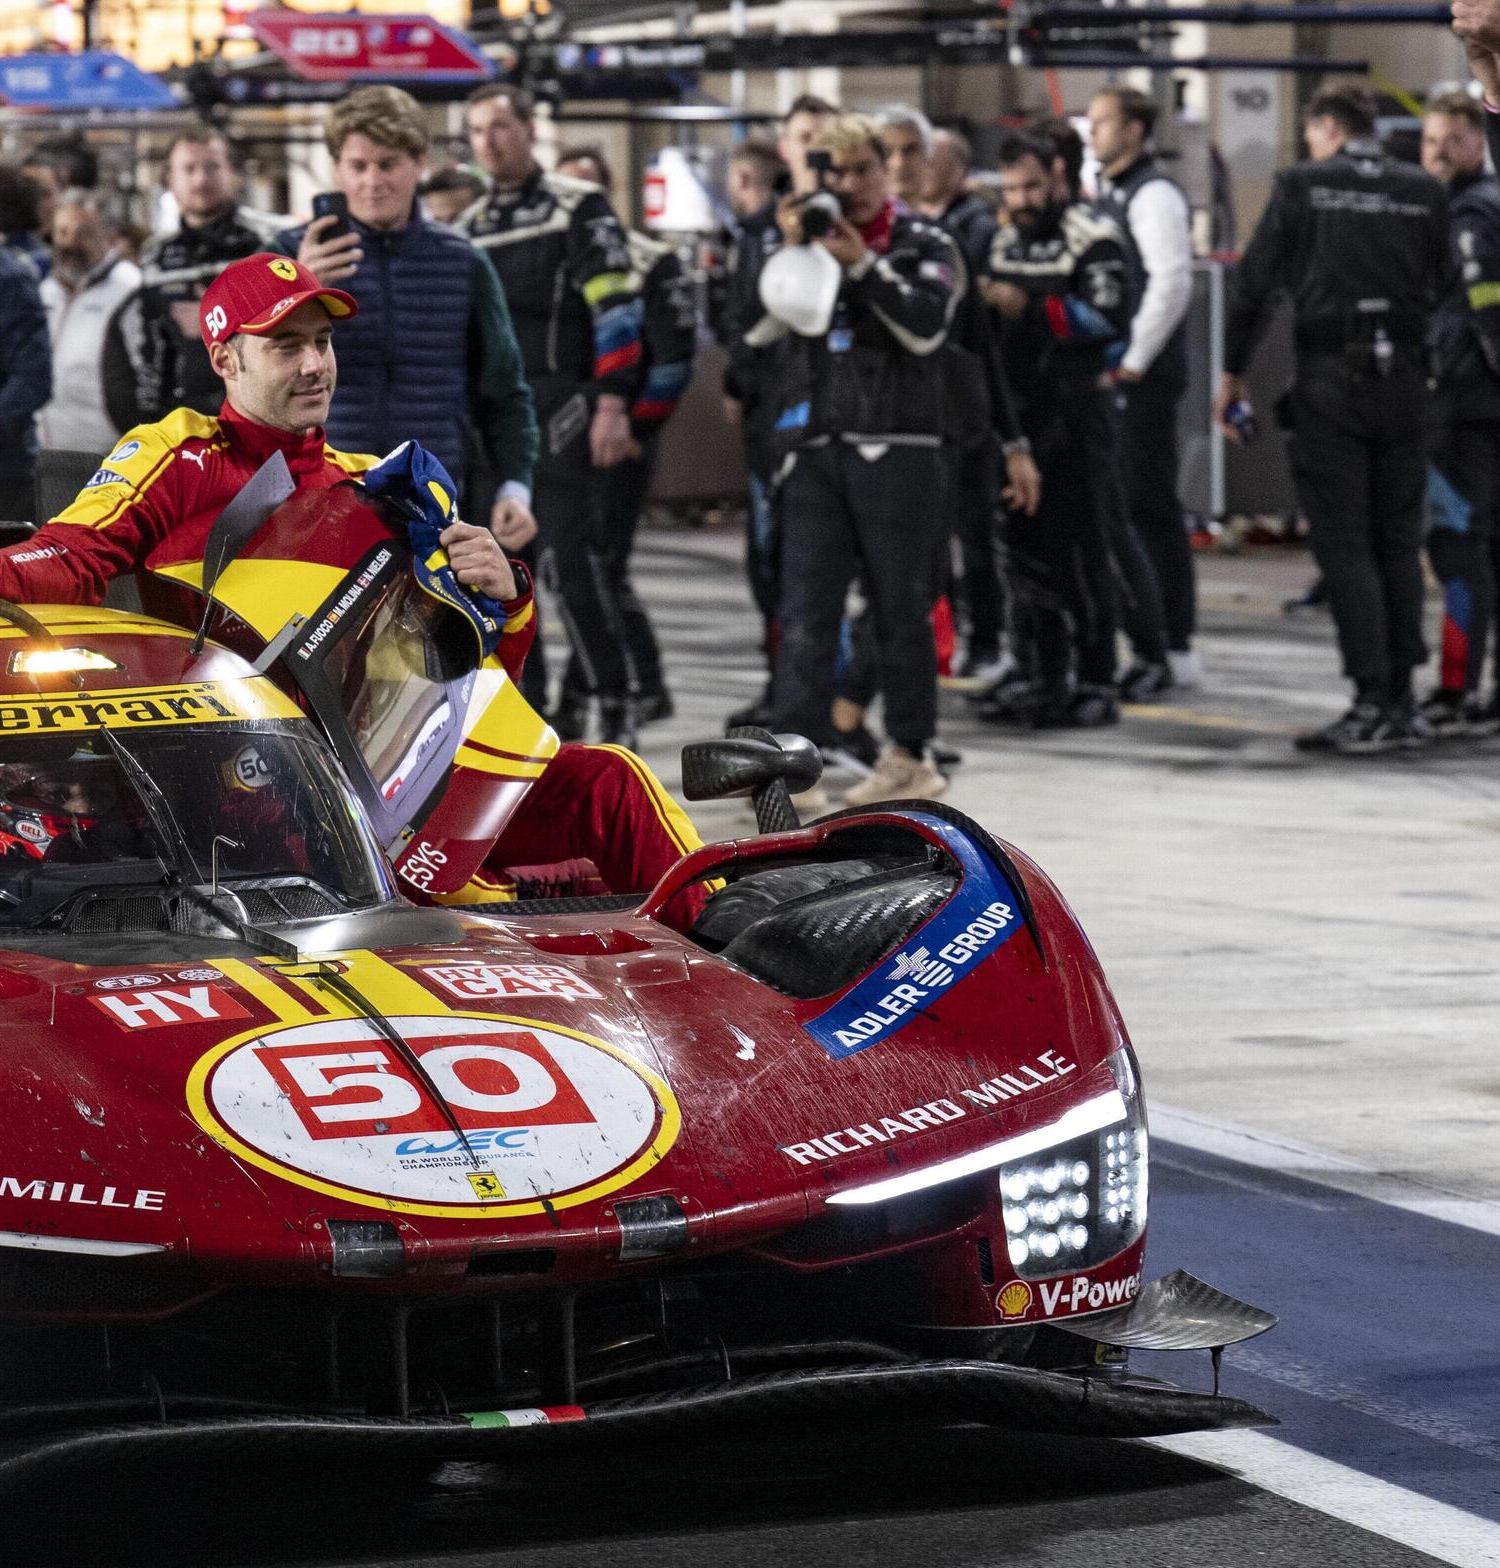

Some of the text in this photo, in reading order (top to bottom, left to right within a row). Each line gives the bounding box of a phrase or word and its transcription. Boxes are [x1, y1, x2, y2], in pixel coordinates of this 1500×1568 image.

[205, 305, 228, 338] 50
[21, 824, 42, 838] BELL
[100, 976, 153, 988] FIA
[432, 965, 568, 980] HYPER
[450, 976, 593, 995] CAR
[831, 901, 1015, 1048] ADLER GROUP
[98, 986, 221, 1028] HY
[278, 1043, 558, 1125] 50
[780, 1048, 1077, 1166] RICHARD MILLE
[395, 1129, 530, 1156] WEC
[400, 1157, 419, 1165] FIA
[420, 1155, 461, 1163] WORLD
